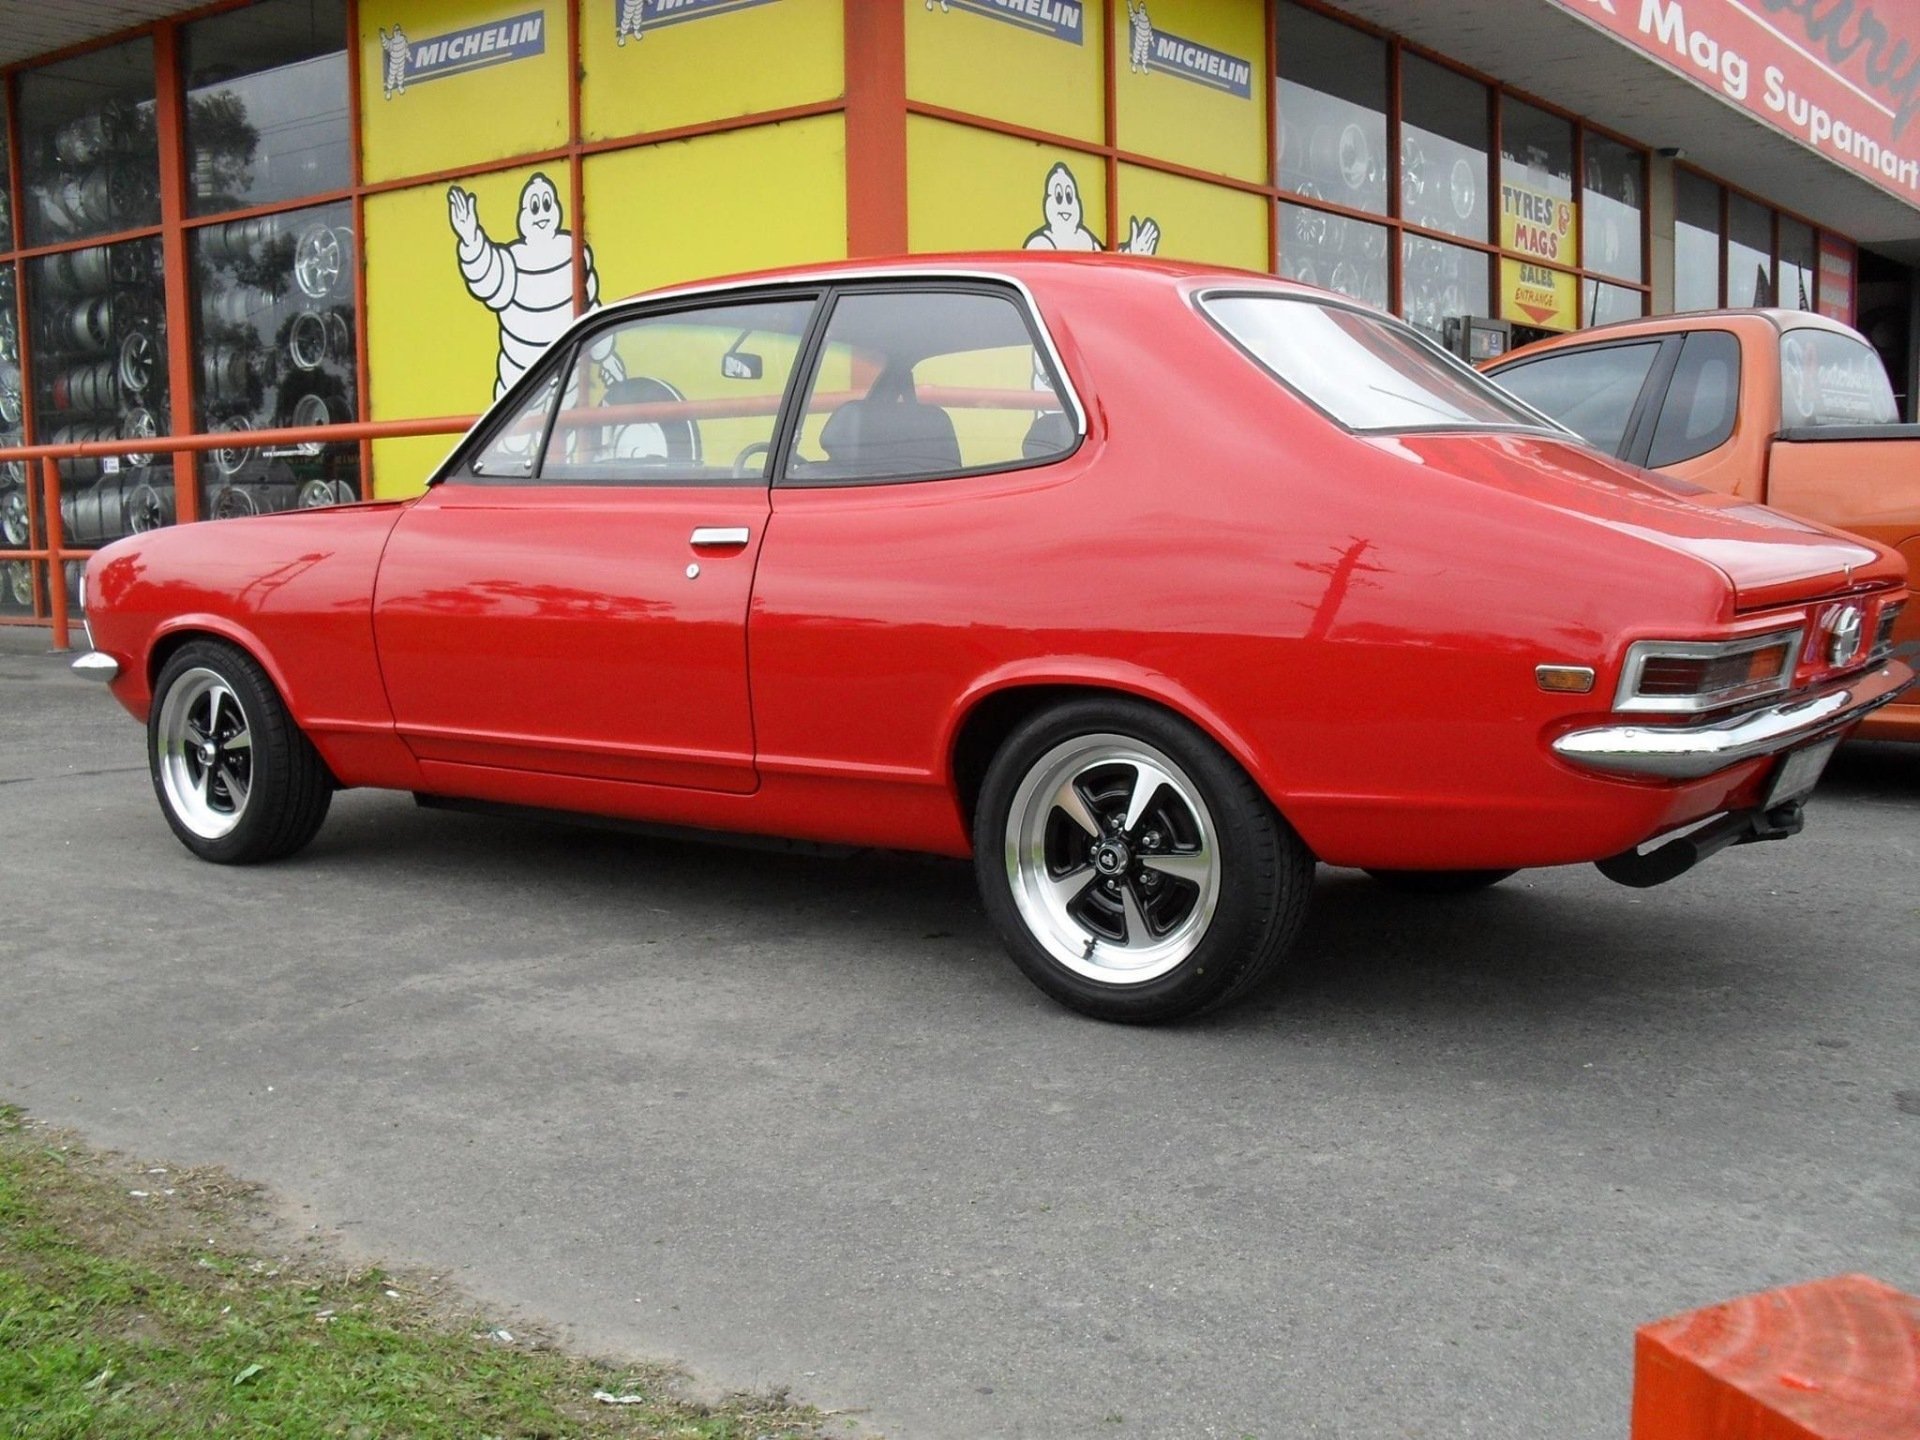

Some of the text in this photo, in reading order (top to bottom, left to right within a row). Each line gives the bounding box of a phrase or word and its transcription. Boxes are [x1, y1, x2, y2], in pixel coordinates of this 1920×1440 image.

[415, 18, 542, 69] MICHELIN
[1157, 37, 1249, 85] MICHELIN
[1638, 0, 1748, 101] Mag
[1763, 65, 1920, 190] Supamart
[1502, 186, 1553, 226] TYRES
[1514, 223, 1558, 259] MAGS
